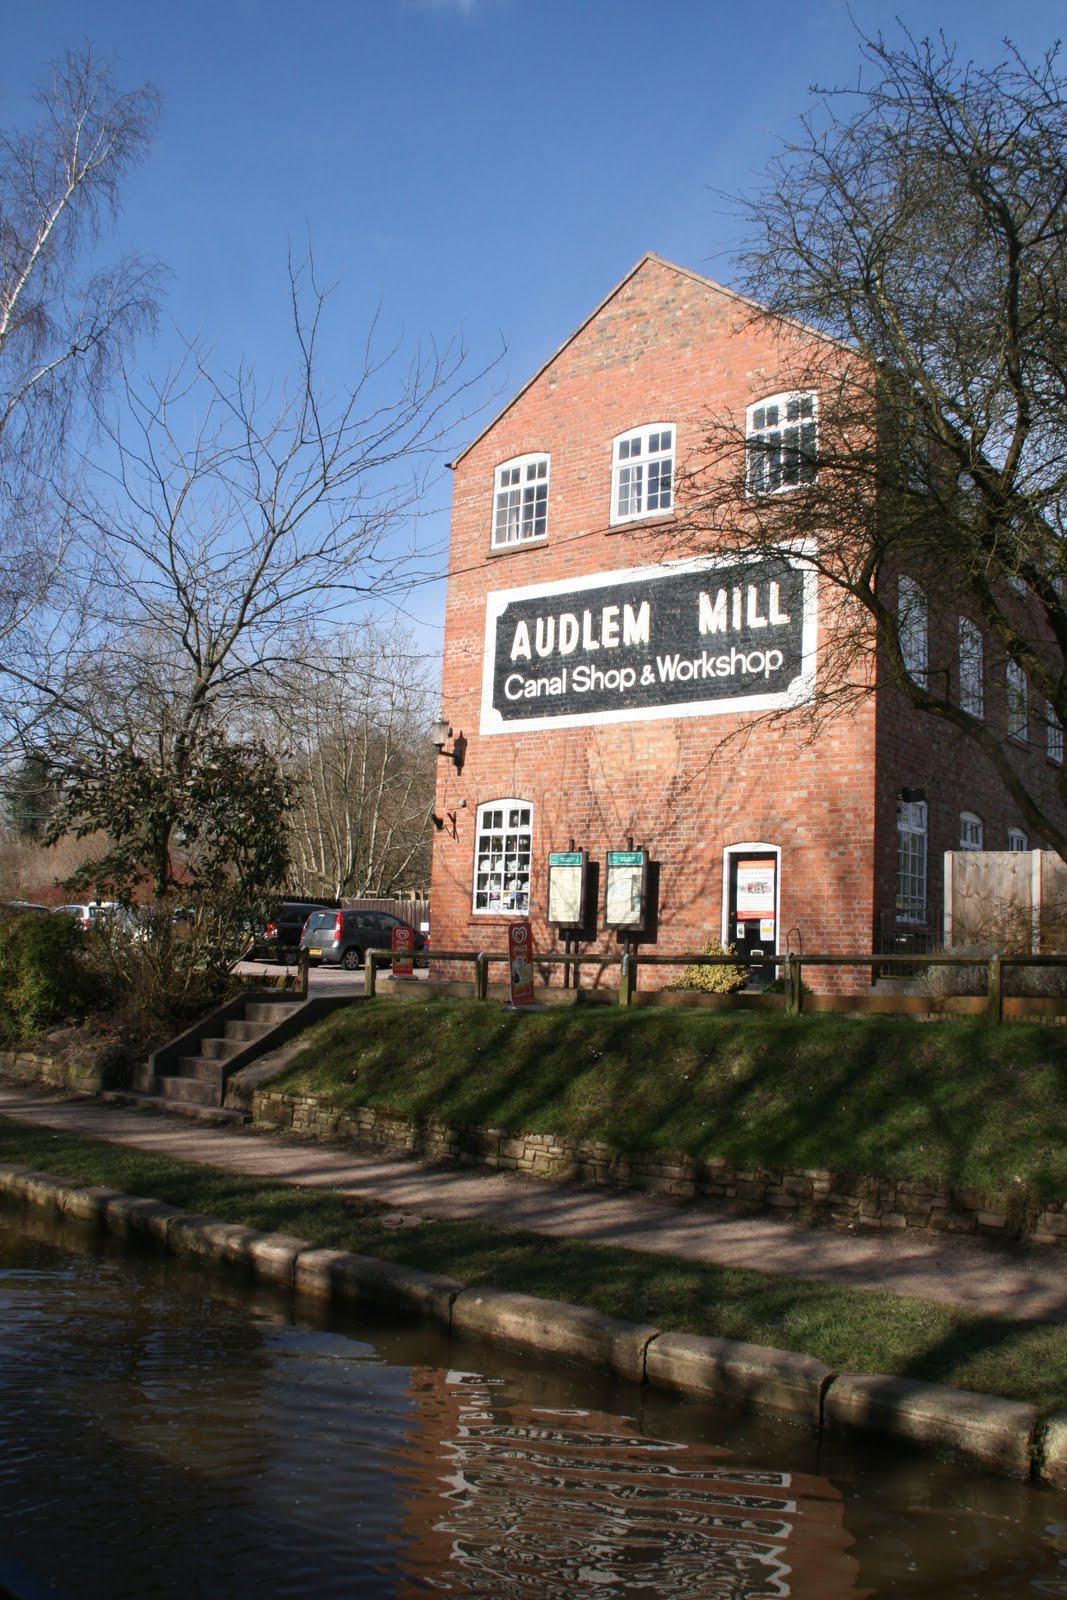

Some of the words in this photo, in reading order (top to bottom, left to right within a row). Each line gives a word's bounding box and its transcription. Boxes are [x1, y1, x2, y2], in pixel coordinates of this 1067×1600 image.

[510, 601, 651, 661] AUDLEM
[699, 581, 791, 635] MILL
[504, 668, 567, 701] Canal
[572, 665, 636, 692] Shop
[641, 667, 656, 686] &
[655, 647, 784, 679] Workshop
